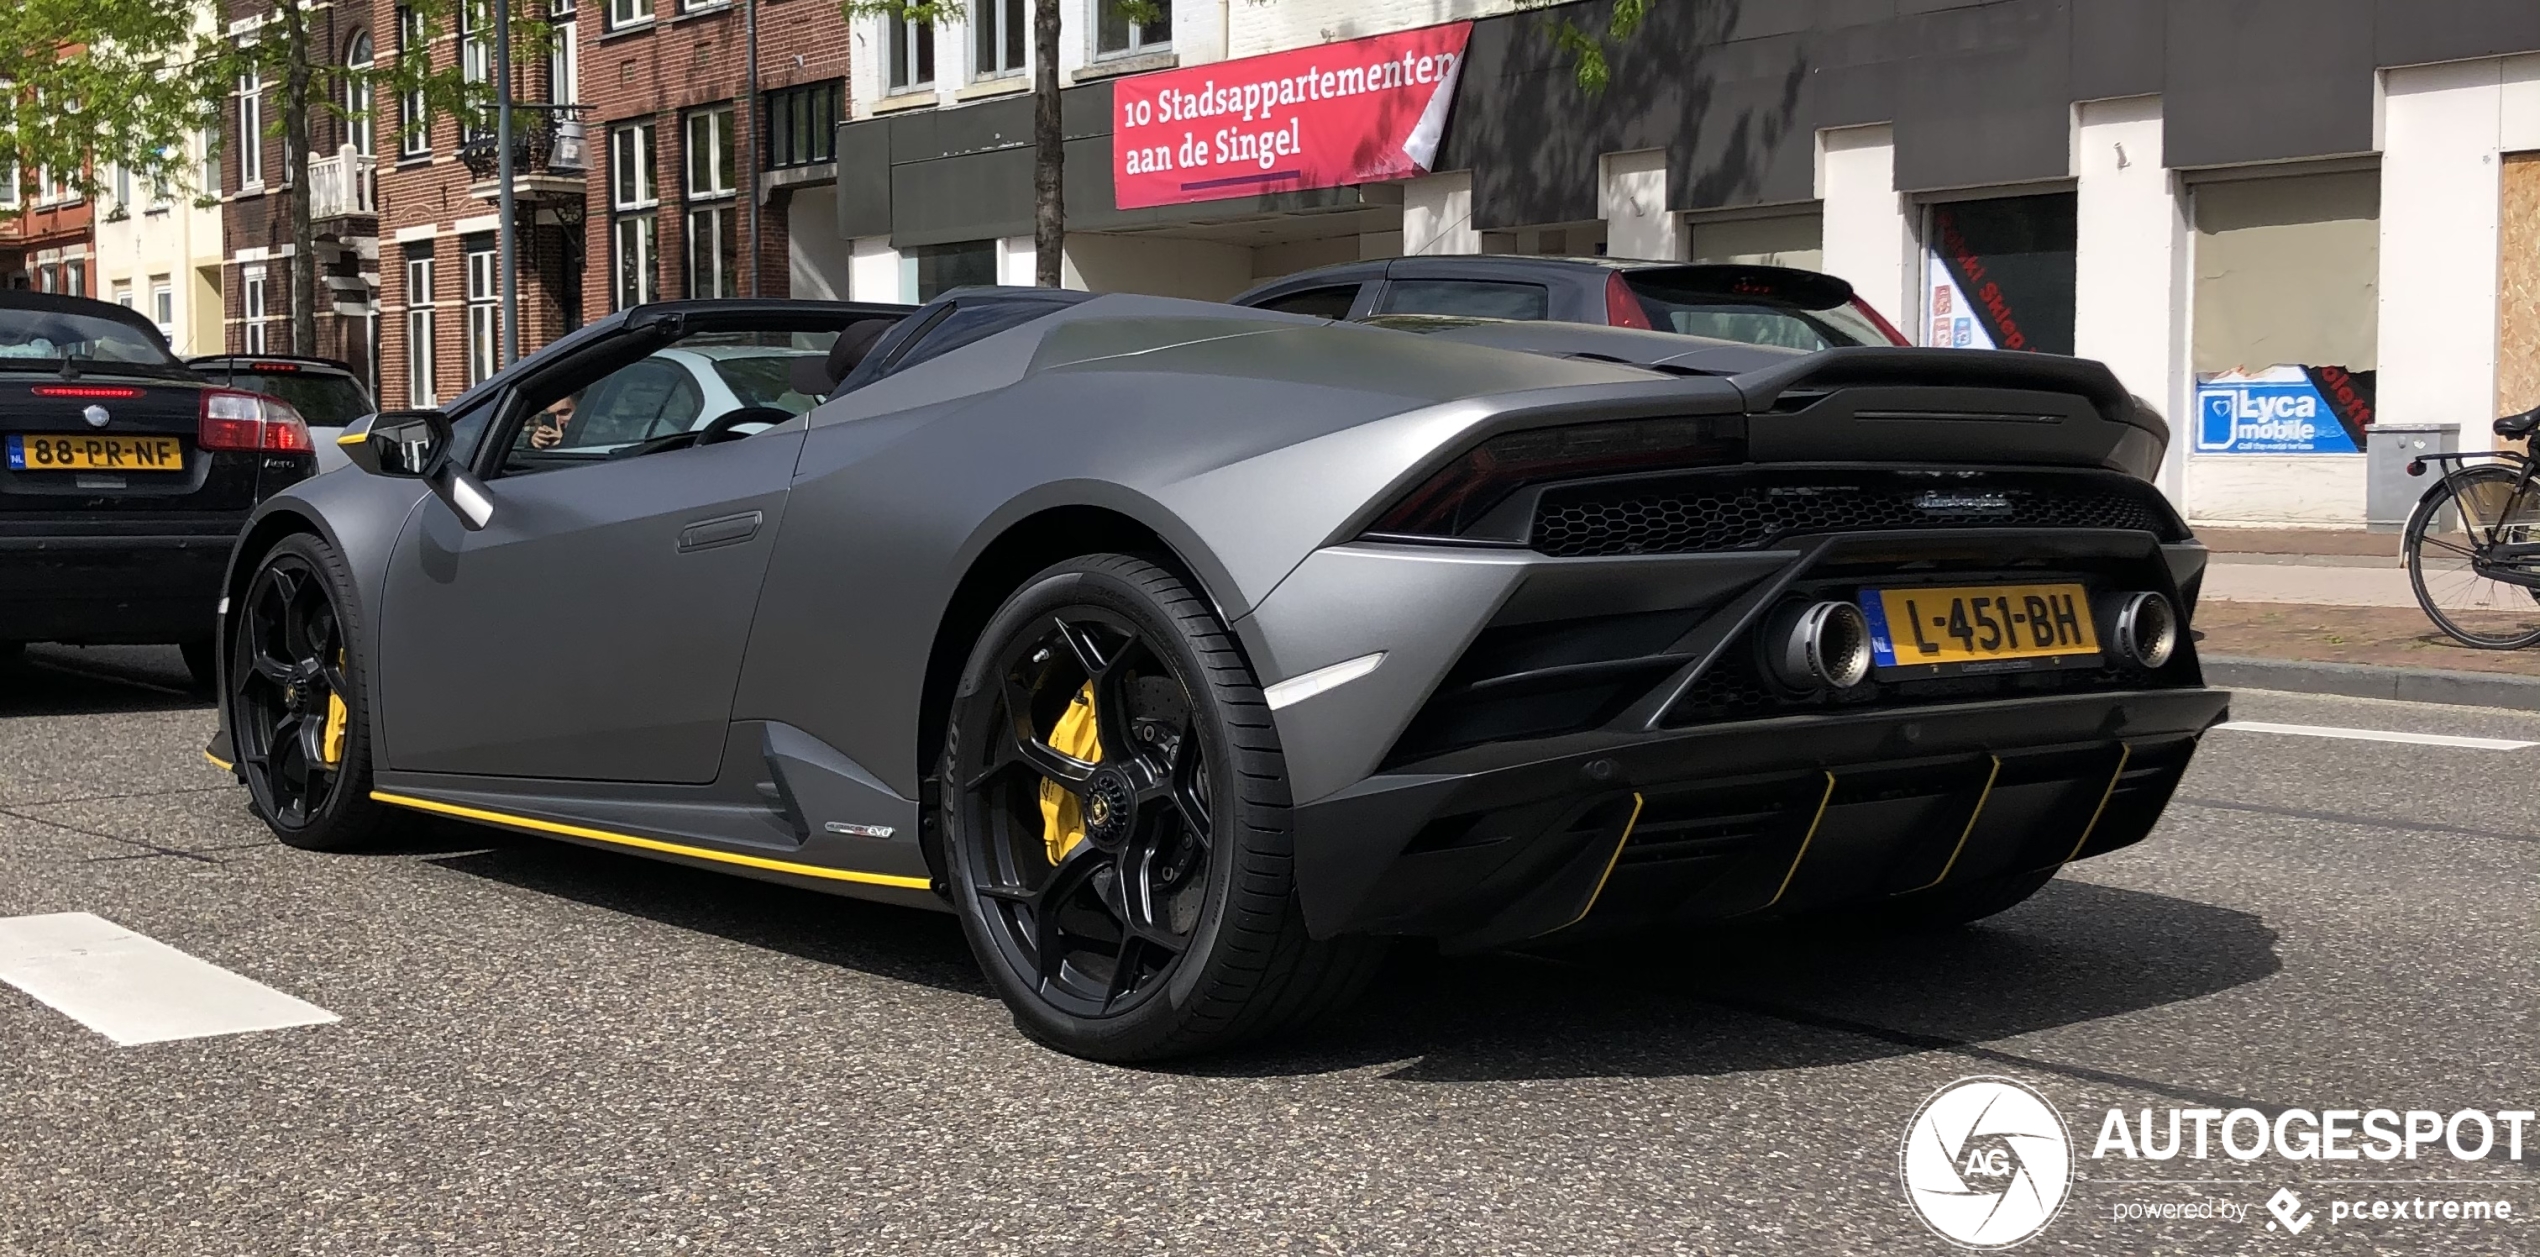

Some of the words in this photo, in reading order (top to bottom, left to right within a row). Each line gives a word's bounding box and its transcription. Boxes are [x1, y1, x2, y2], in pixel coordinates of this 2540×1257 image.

[1124, 100, 1151, 128] 10
[1157, 49, 1456, 122] Stadsappartementen
[1126, 145, 1173, 175] aan
[1178, 132, 1208, 169] de
[1215, 117, 1301, 170] Singel
[2239, 390, 2316, 424] Lyca
[2238, 420, 2315, 441] mobile
[11, 454, 23, 464] NL
[35, 438, 171, 466] 88-PR-NF
[1906, 594, 2082, 655] L-451-BH
[1872, 637, 1891, 653] NL
